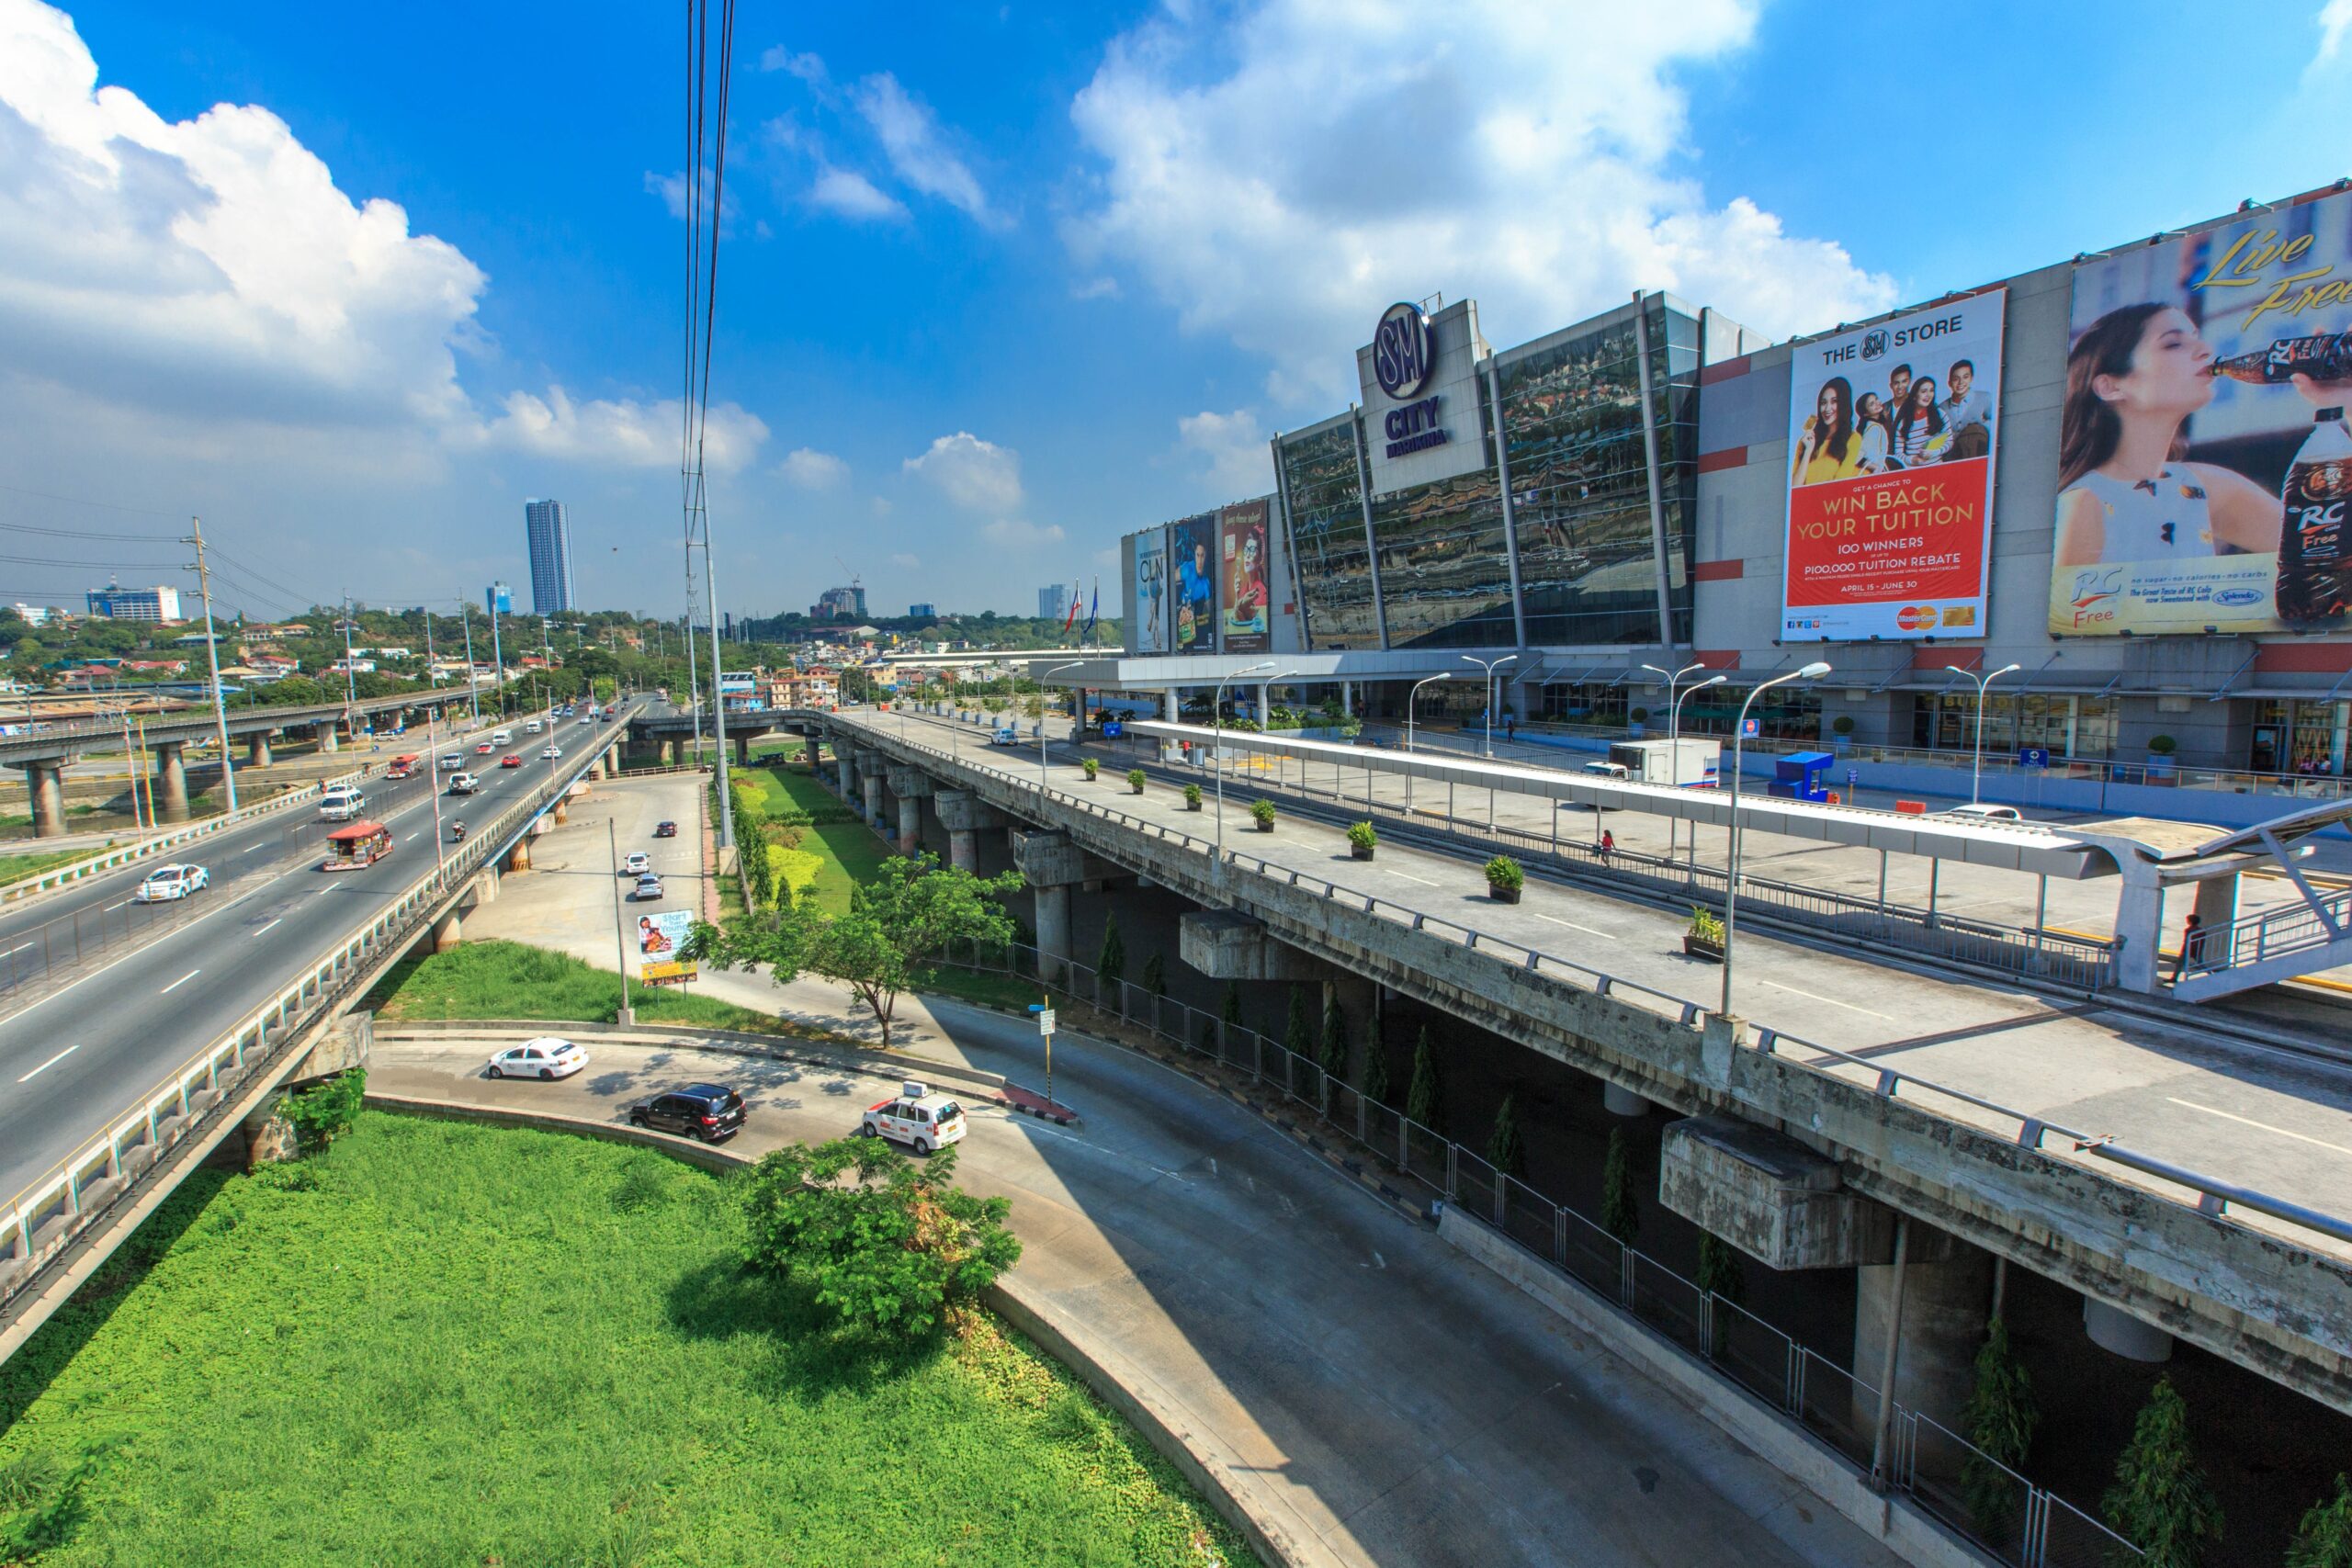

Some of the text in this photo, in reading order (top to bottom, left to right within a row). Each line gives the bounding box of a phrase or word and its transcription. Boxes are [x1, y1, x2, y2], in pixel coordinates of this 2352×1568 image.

[2191, 229, 2314, 292] Live
[1377, 309, 1427, 394] SM
[1823, 314, 1962, 366] THE SM STORE
[1385, 396, 1440, 441] CITY
[1386, 429, 1447, 458] MARIKINA
[1823, 483, 1945, 515] WIN BACK
[1873, 479, 1901, 490] CHANCE
[1797, 502, 1973, 540] YOUR TUITION
[2298, 502, 2346, 531] RC
[1838, 536, 1924, 555] 100 WINNERS
[2302, 533, 2338, 549] Free
[1140, 557, 1163, 582] CLN
[1804, 553, 1961, 575] P100,000 TUITION REBATE
[1840, 584, 1864, 592] APRIL
[1882, 581, 1904, 590] JUNE
[2070, 567, 2123, 604] RC
[1897, 615, 1937, 623] MasterCard
[2074, 610, 2113, 628] Free
